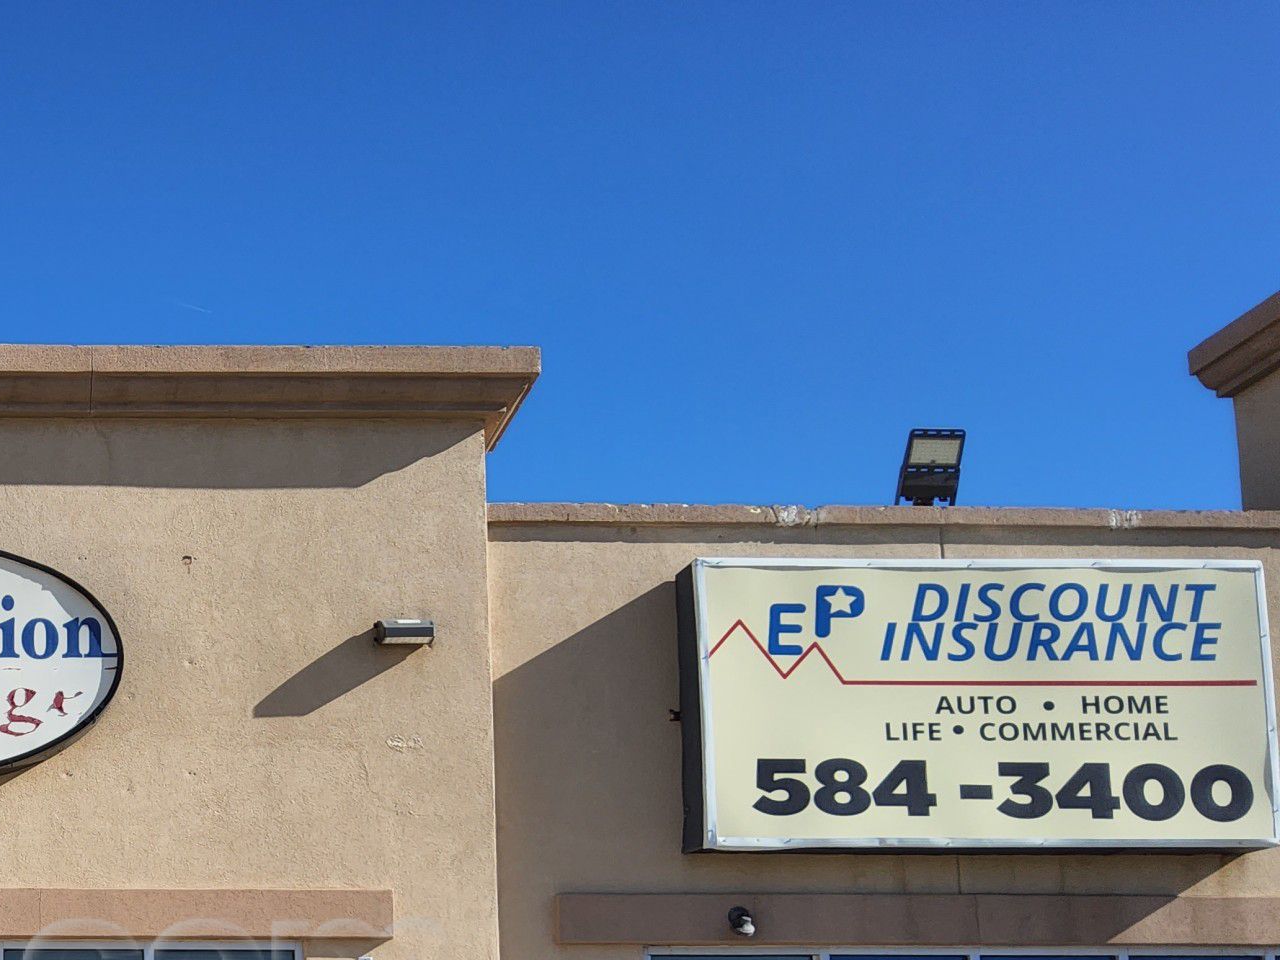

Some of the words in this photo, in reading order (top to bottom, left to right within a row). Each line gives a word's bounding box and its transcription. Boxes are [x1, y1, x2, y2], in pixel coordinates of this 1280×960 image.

[768, 585, 865, 655] EP
[911, 583, 1216, 622] DISCOUNT
[880, 622, 1220, 662] INSURANCE
[935, 695, 1017, 715] AUTO
[1081, 695, 1169, 715] HOME
[886, 722, 942, 741] LIFE
[979, 721, 1178, 741] COMMERCIAL
